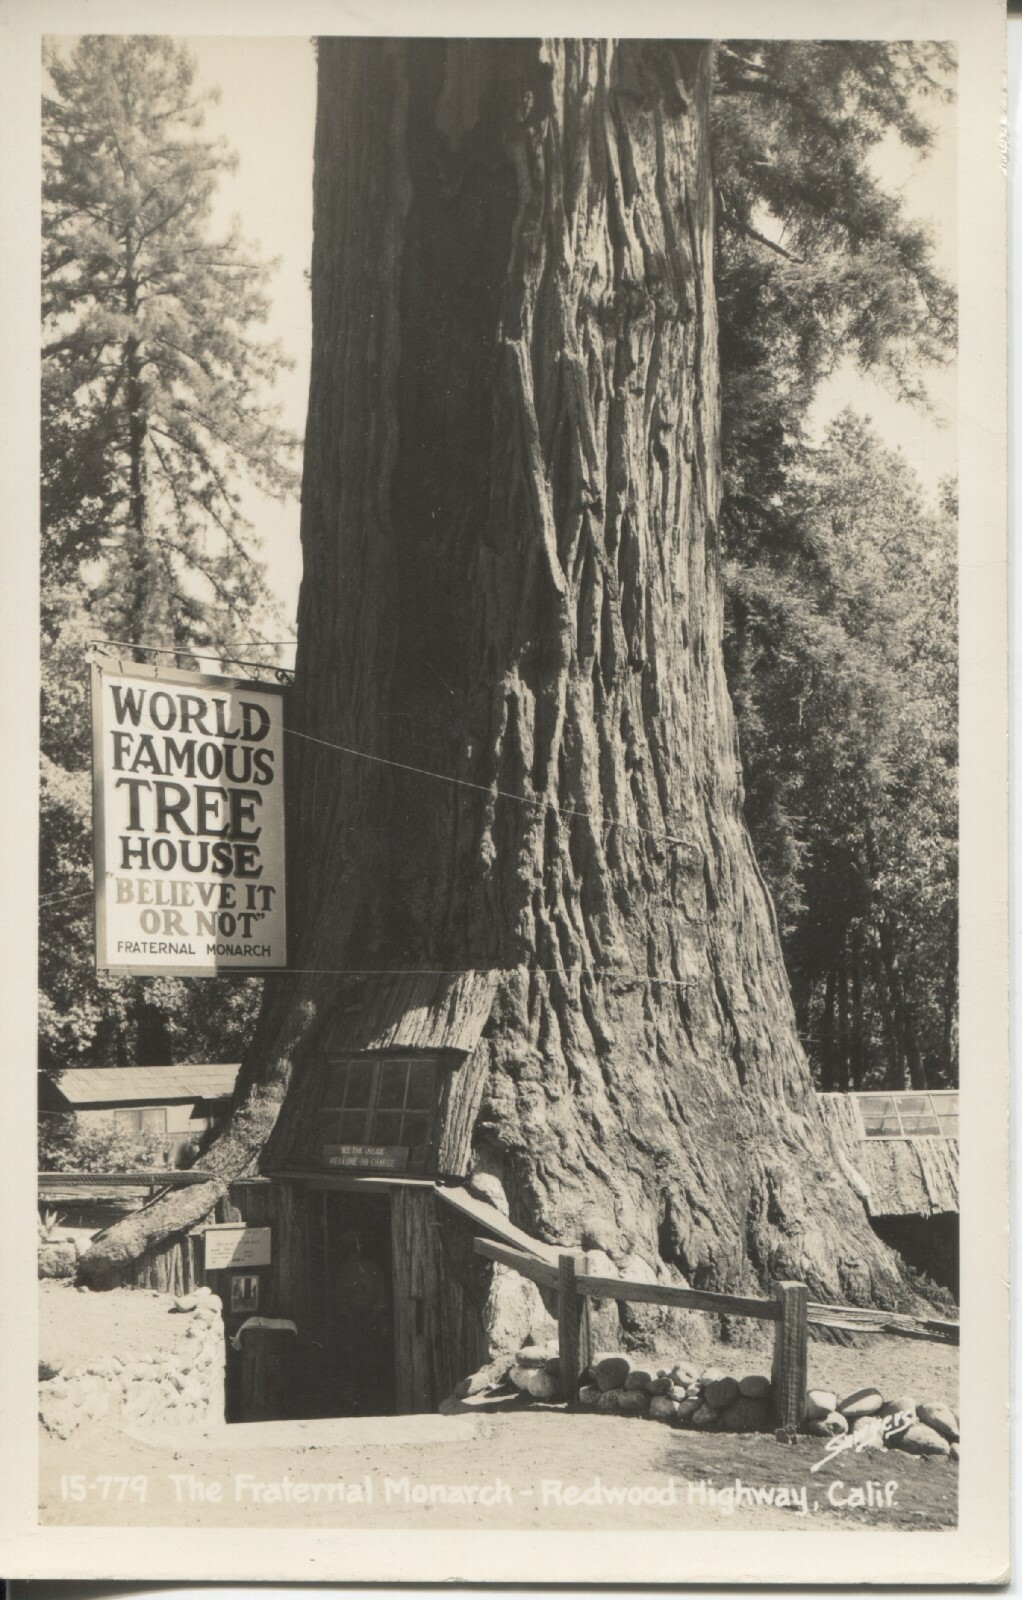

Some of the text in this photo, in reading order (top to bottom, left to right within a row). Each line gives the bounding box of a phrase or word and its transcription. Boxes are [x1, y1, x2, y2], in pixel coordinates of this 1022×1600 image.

[109, 685, 271, 742] WORLD
[110, 730, 275, 785] FAMOUS
[115, 777, 262, 843] TREE
[119, 835, 263, 879] HOUSE
[245, 884, 276, 911] IT
[139, 909, 188, 936] OR
[117, 941, 271, 958] FRATERNAL MONARCH
[352, 1146, 363, 1155] THE
